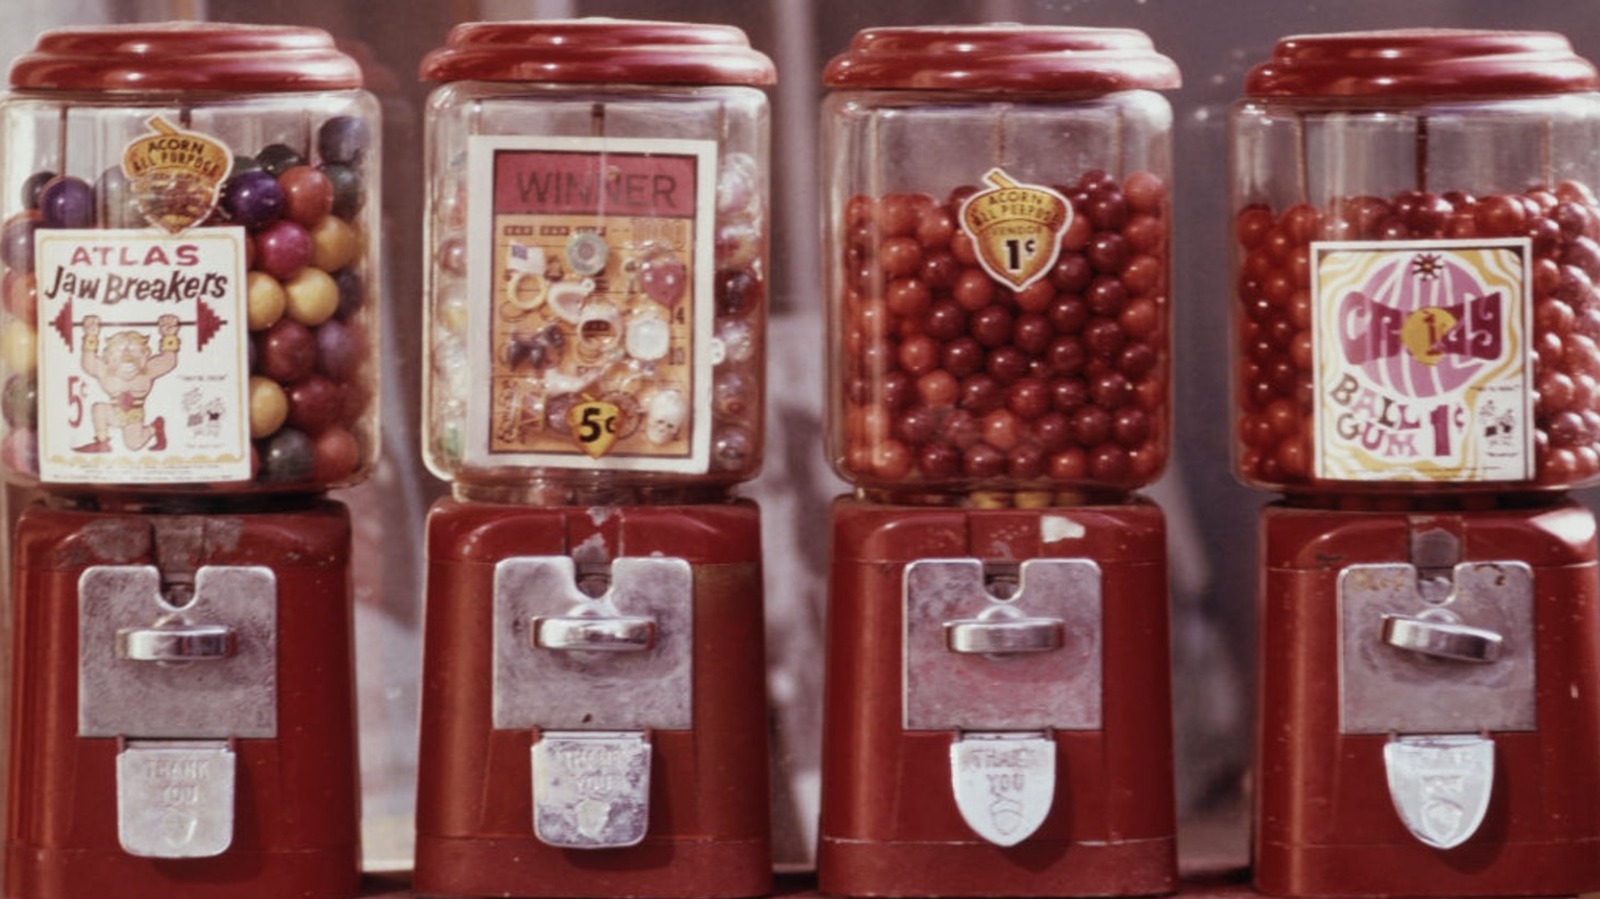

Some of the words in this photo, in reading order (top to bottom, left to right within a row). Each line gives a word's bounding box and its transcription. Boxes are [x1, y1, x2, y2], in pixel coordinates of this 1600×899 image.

[148, 138, 205, 156] ACORN
[516, 170, 678, 208] WINNER
[988, 191, 1043, 205] ACORN
[70, 245, 200, 266] ATLAS
[45, 266, 100, 299] Jaw
[102, 270, 228, 304] Breakers
[1331, 374, 1420, 430] BALL
[1336, 413, 1419, 457] GUM
